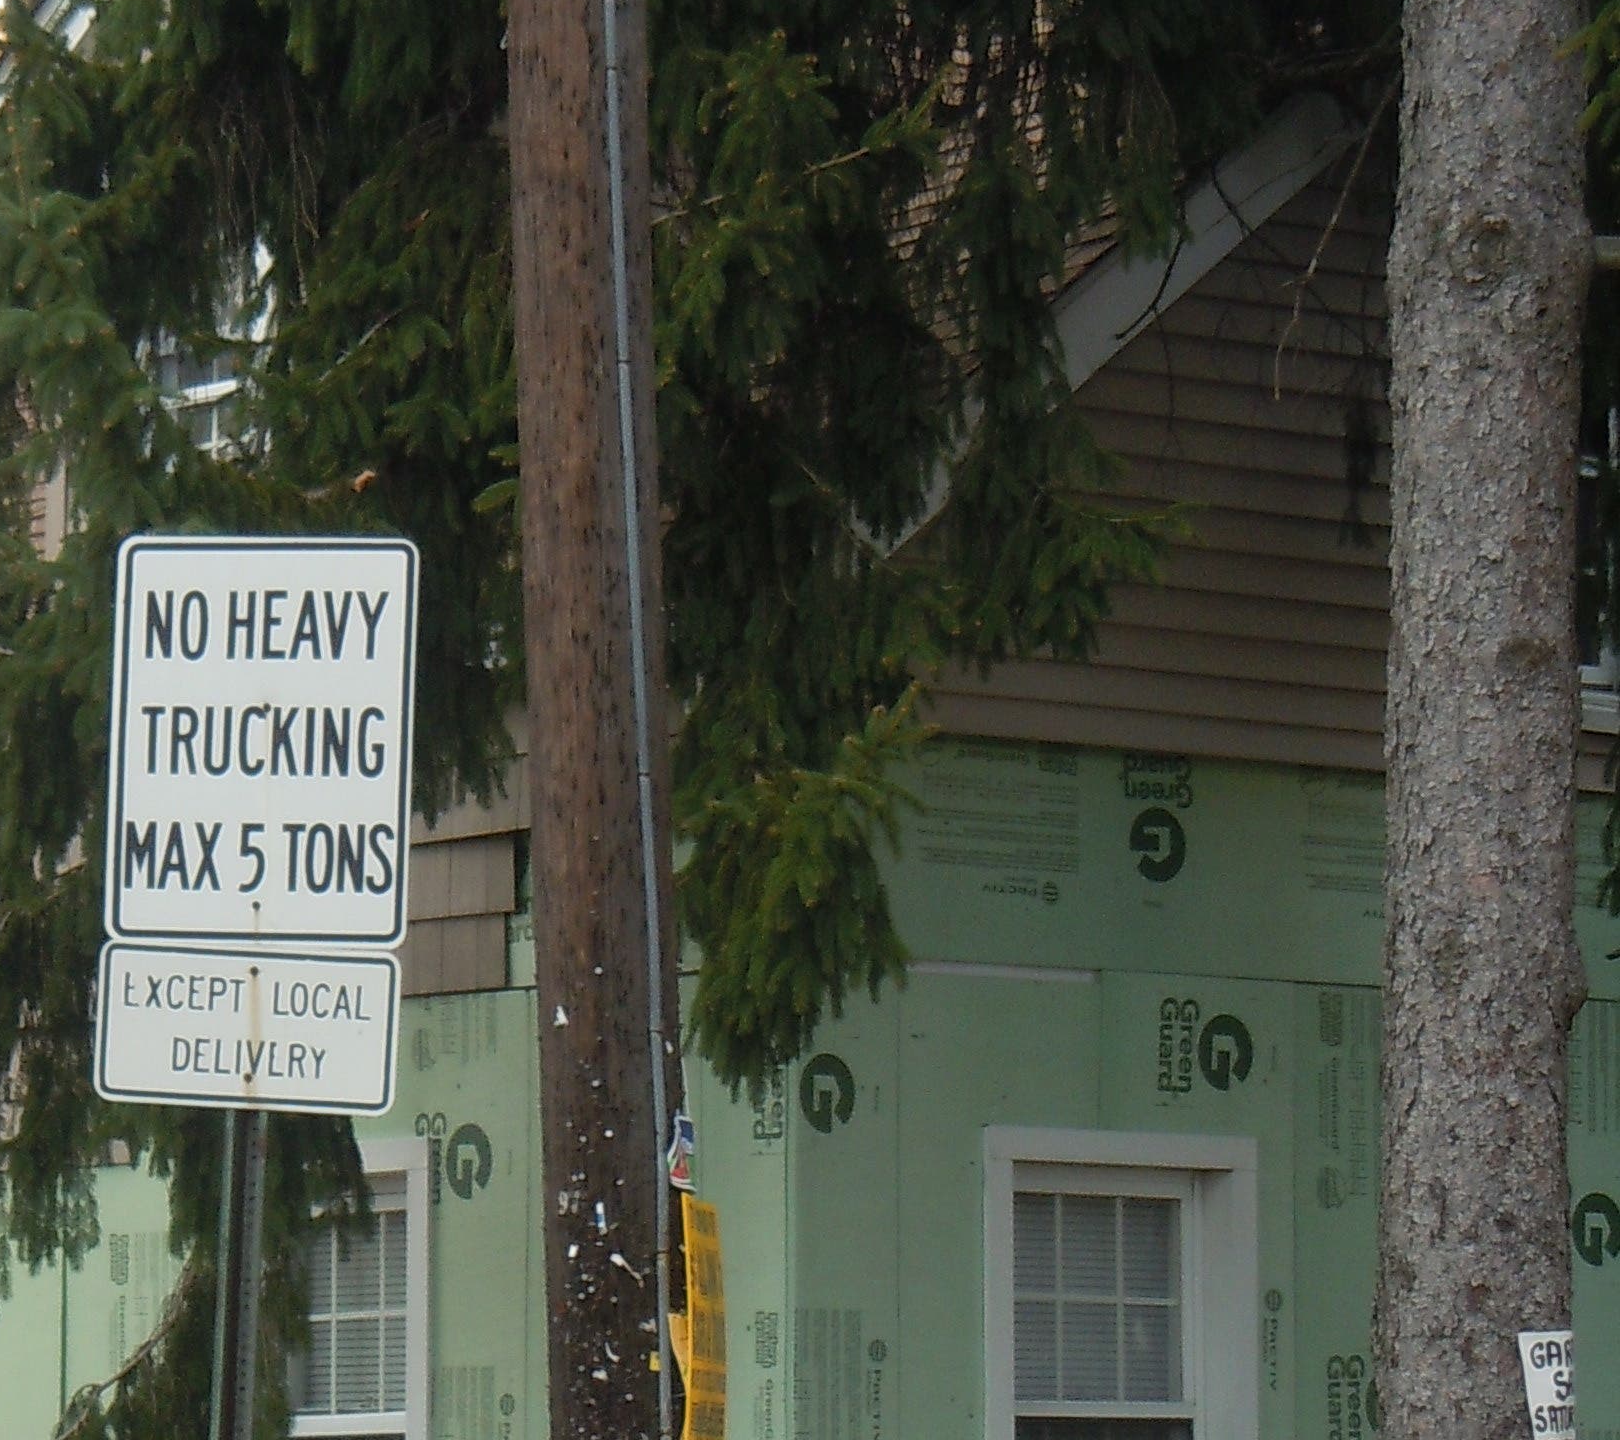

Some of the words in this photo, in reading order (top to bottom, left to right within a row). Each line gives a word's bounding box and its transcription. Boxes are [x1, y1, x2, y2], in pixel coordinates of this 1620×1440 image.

[145, 590, 208, 660] NO
[226, 590, 389, 660] HEAVY
[142, 706, 386, 779] TRUCKING
[125, 821, 223, 892] MAX
[238, 823, 266, 893] 5
[283, 823, 395, 894] TONS
[272, 980, 371, 1021] LOCAL
